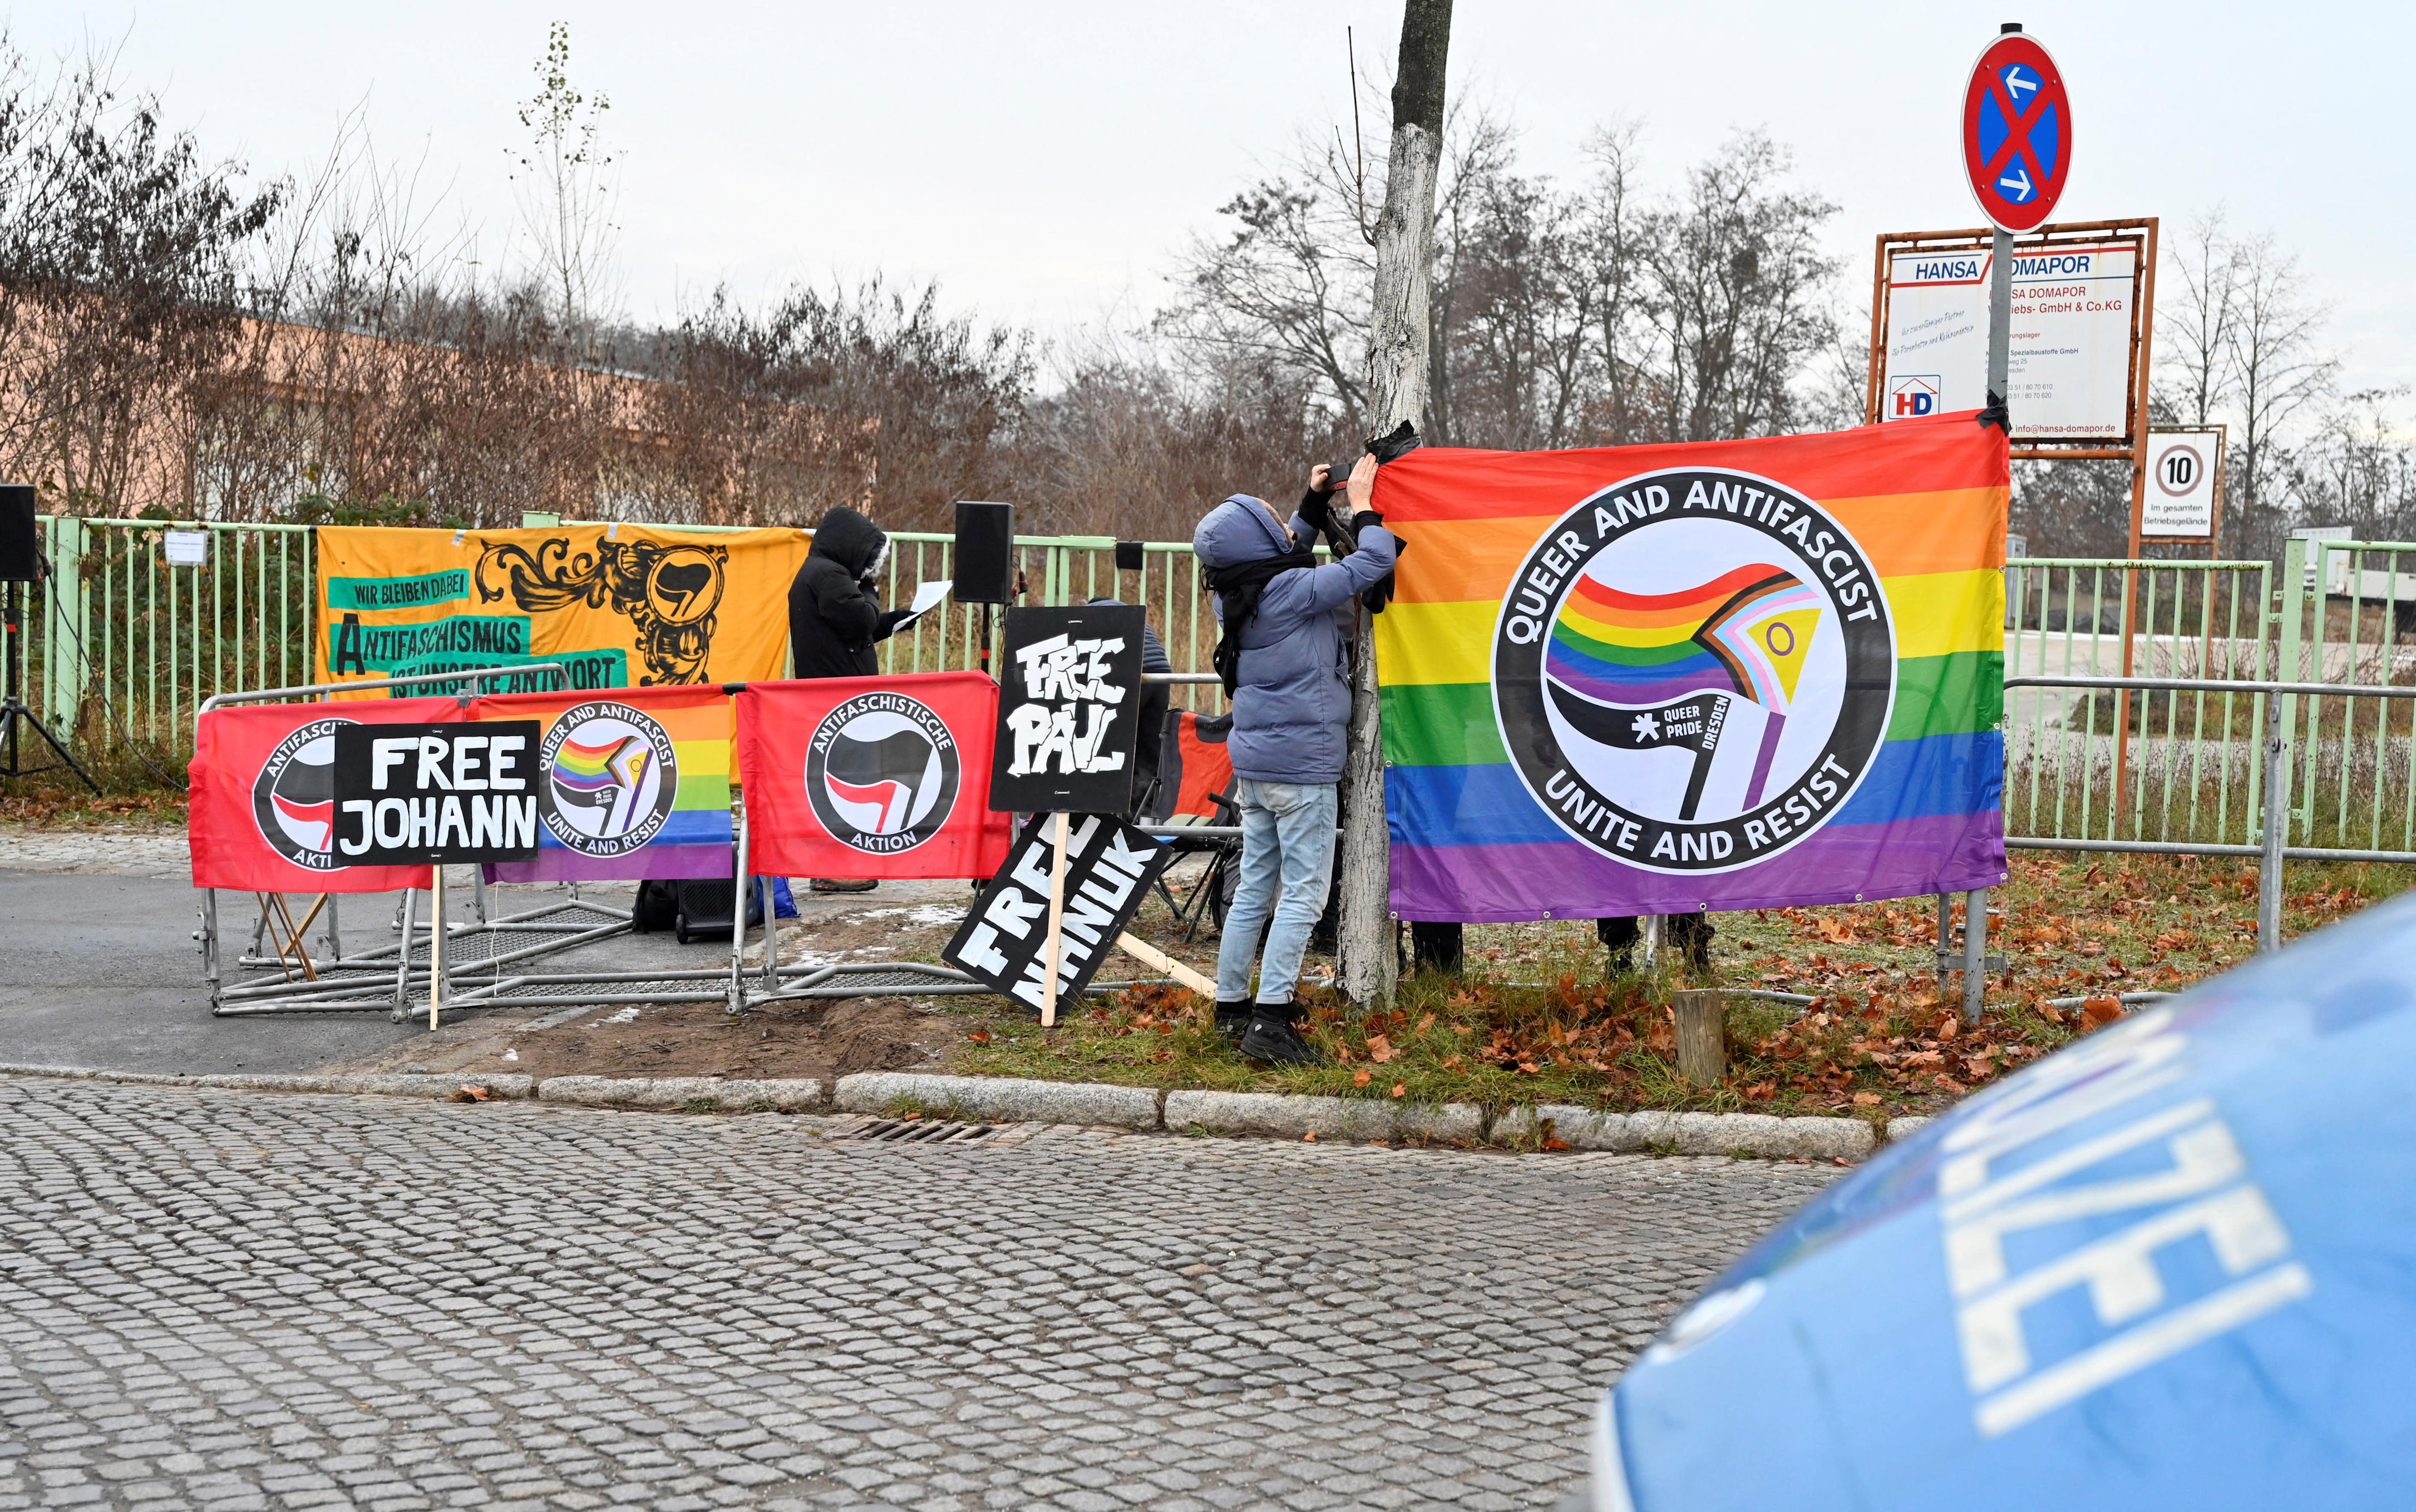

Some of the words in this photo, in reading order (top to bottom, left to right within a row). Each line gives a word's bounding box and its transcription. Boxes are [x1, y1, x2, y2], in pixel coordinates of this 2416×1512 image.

[1916, 260, 1978, 279] HANSA
[2029, 286, 2086, 299] DOMAPOR
[2039, 302, 2072, 313] GmbH
[2075, 302, 2083, 312] &
[2086, 300, 2122, 312] Co.KG
[2010, 348, 2058, 357] Spezialbaustoffe
[1896, 392, 1932, 416] HD
[2015, 424, 2116, 434] info@hansa-domapor.de
[2167, 457, 2192, 484] 10
[2144, 516, 2208, 526] Betriebsgelände
[2163, 503, 2203, 513] gesamten
[1506, 530, 1590, 645] QUEER
[1594, 485, 1670, 540] AND
[1682, 480, 1877, 622] ANTIFASCIST
[354, 585, 378, 605] WIR
[381, 580, 430, 604] BLEIBEN
[431, 573, 465, 599] DABEI
[336, 612, 521, 676] ANTIFASCHISMUS
[391, 667, 416, 699] IST
[1015, 633, 1126, 704] FREE
[813, 695, 952, 754] ANTIFASCHISTISCHE
[1663, 705, 1700, 723] QUEER
[1665, 720, 1703, 739] PRIDE
[1701, 695, 1729, 750] DRESDEN
[539, 723, 569, 772] QUEER
[566, 706, 596, 728] AND
[599, 704, 674, 768] ANTIFASCIST
[1006, 702, 1126, 778] PAUL
[372, 735, 526, 790] FREE
[1544, 769, 1644, 852] UNITE
[1650, 831, 1734, 862] AND
[1743, 753, 1851, 851] RESIST
[340, 794, 537, 856] JOHANN
[547, 811, 585, 849] UNITE
[585, 839, 619, 854] AND
[622, 808, 664, 850] RESIST
[850, 831, 918, 851] AKTION
[293, 849, 332, 868] AKTI
[957, 812, 1101, 977] FREE
[1011, 827, 1158, 1010] NANUK
